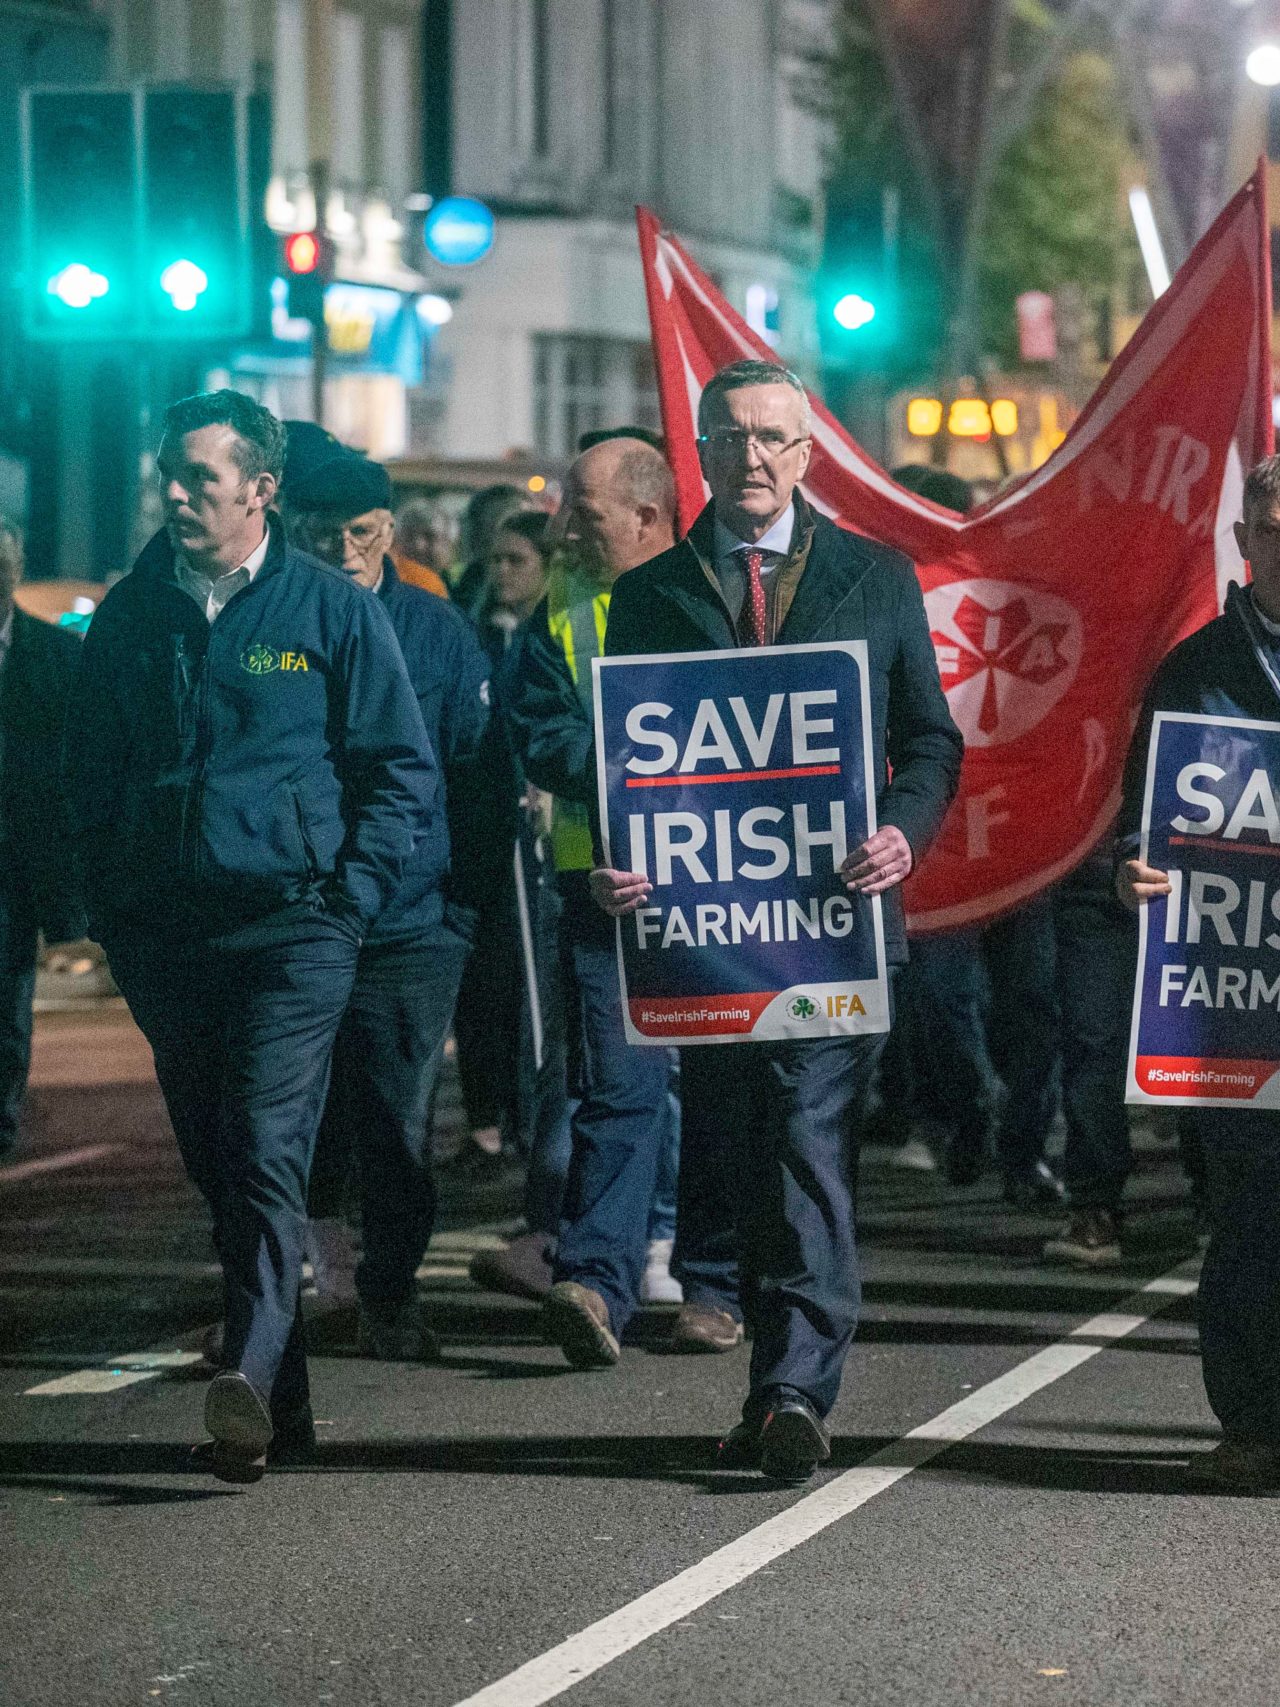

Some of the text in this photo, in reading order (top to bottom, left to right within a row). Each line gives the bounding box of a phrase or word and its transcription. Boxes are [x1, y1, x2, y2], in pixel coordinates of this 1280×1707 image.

[281, 652, 309, 671] IFA
[625, 690, 840, 775] SAVE
[629, 800, 847, 886] IRISH
[635, 895, 853, 950] FARMING
[641, 1008, 750, 1023] #SaveIrishFarming
[826, 994, 867, 1018] IFA
[1147, 1069, 1255, 1087] #SaveIrishFarming
